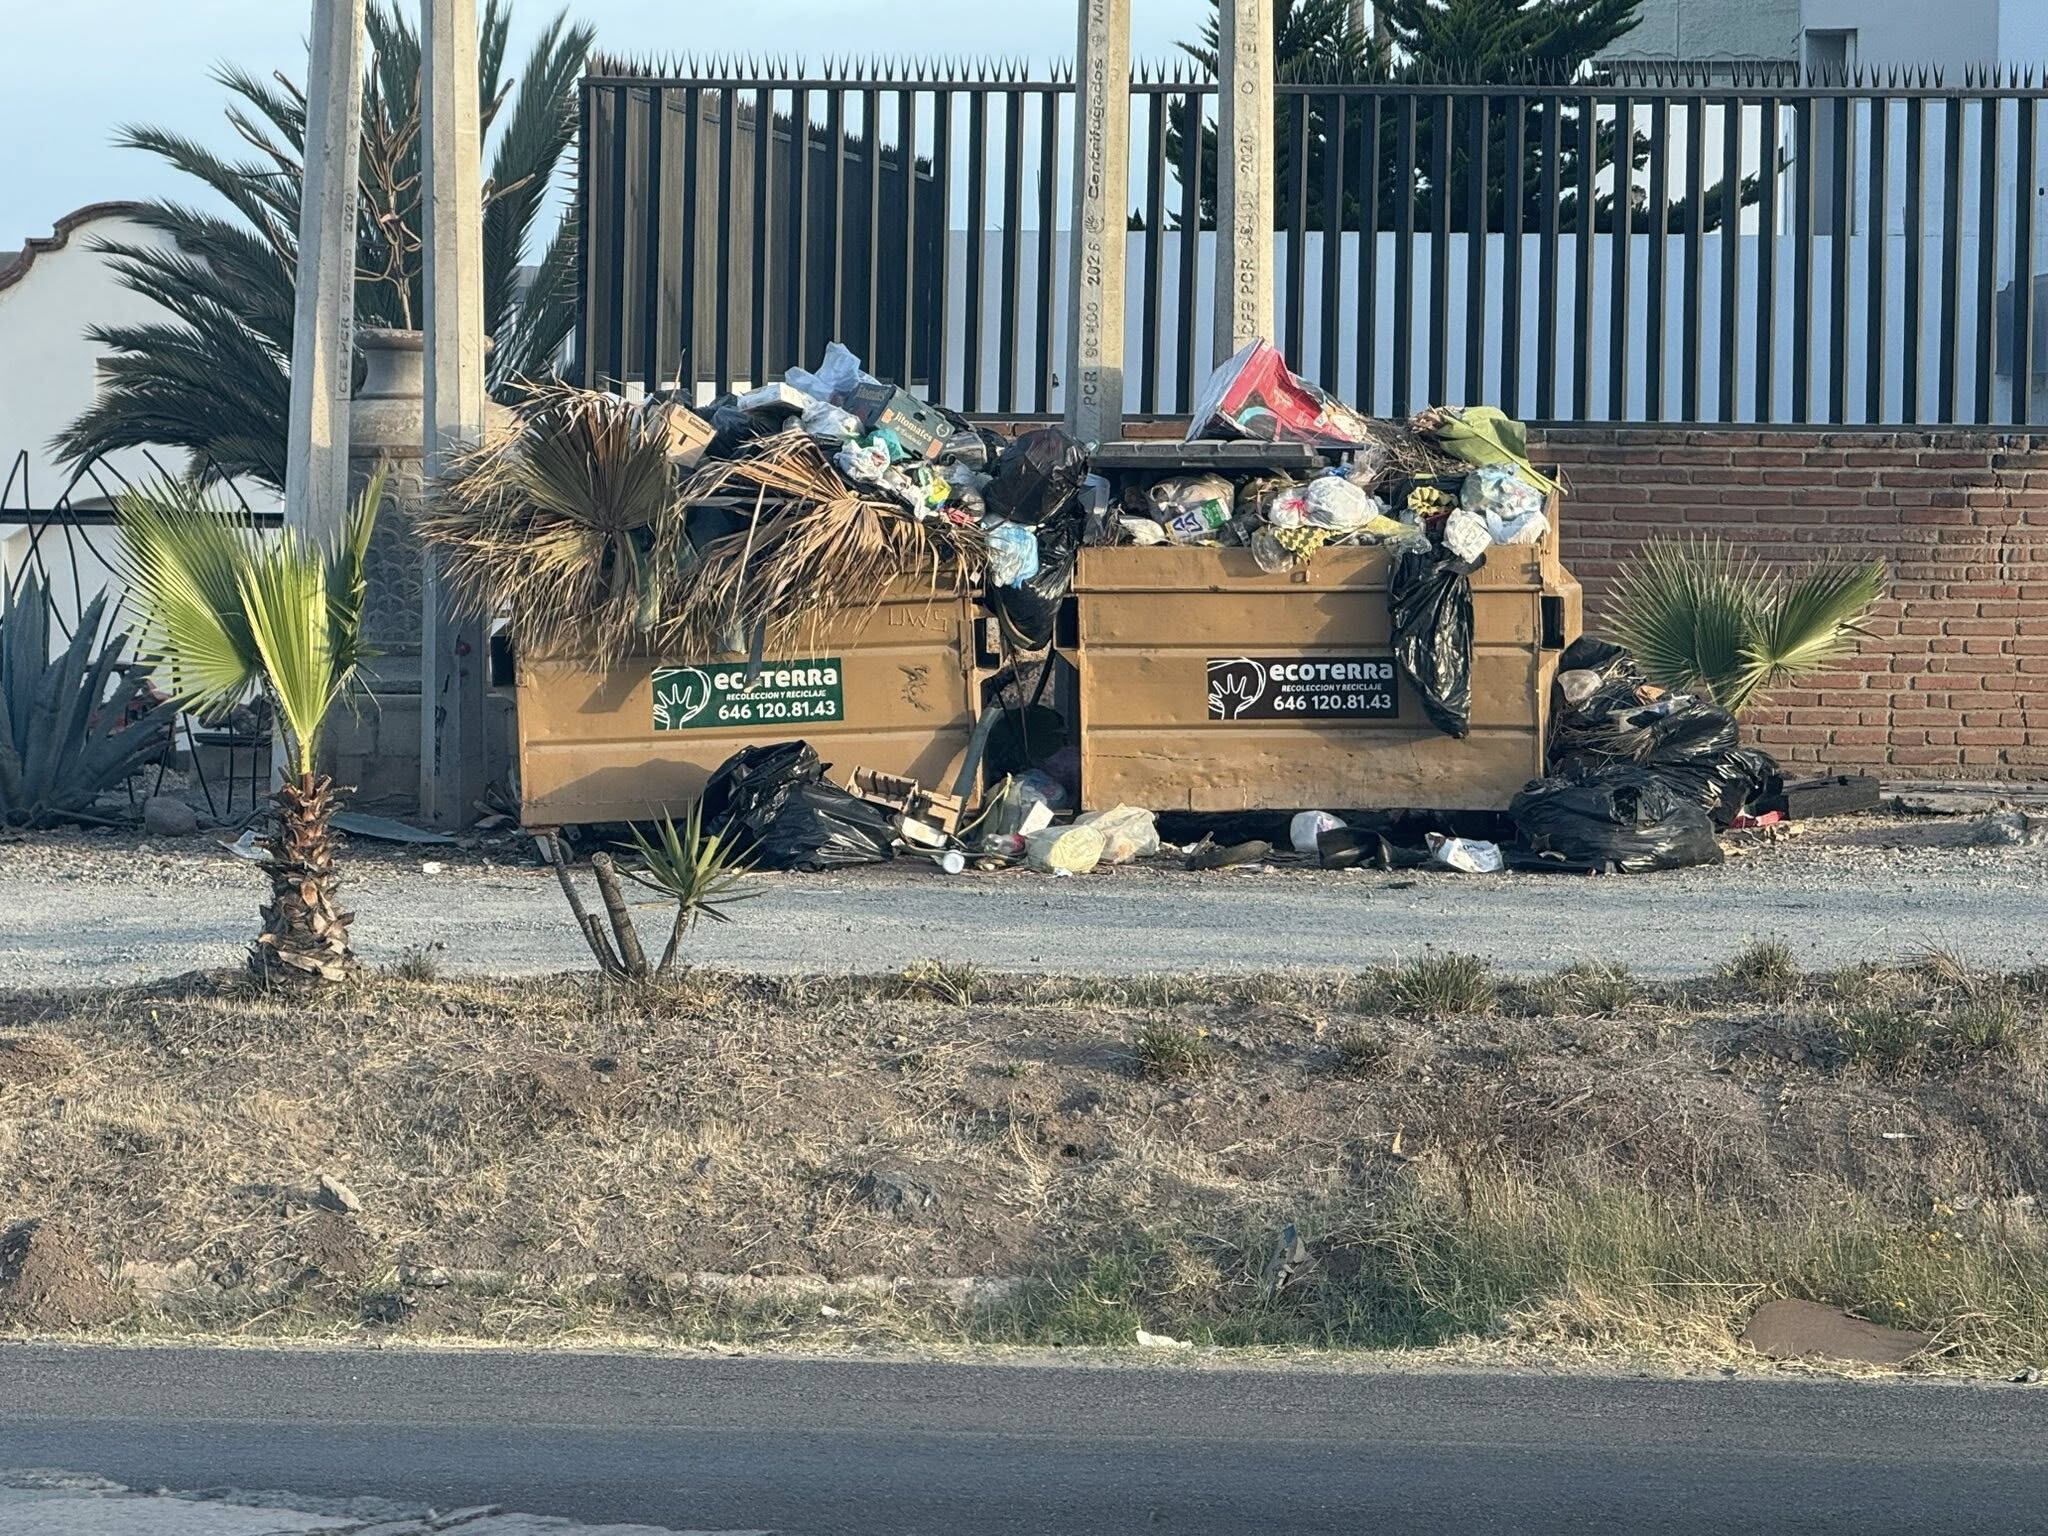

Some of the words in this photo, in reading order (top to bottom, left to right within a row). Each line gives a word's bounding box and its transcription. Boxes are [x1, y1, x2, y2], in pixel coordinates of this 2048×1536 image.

[1088, 58, 1104, 201] Centrifugados
[1083, 371, 1097, 406] PCR
[893, 411, 933, 442] Jitomates
[726, 691, 780, 701] RECOLECCION
[780, 691, 786, 699] Y
[786, 689, 827, 699] RECICLAJE
[1281, 684, 1335, 692] RECOLECCION
[1341, 683, 1382, 691] RECICLAJE
[718, 703, 752, 720] 646
[756, 700, 836, 719] 120.81.43
[1273, 695, 1307, 711] 646
[1311, 694, 1392, 710] 120.81.43
